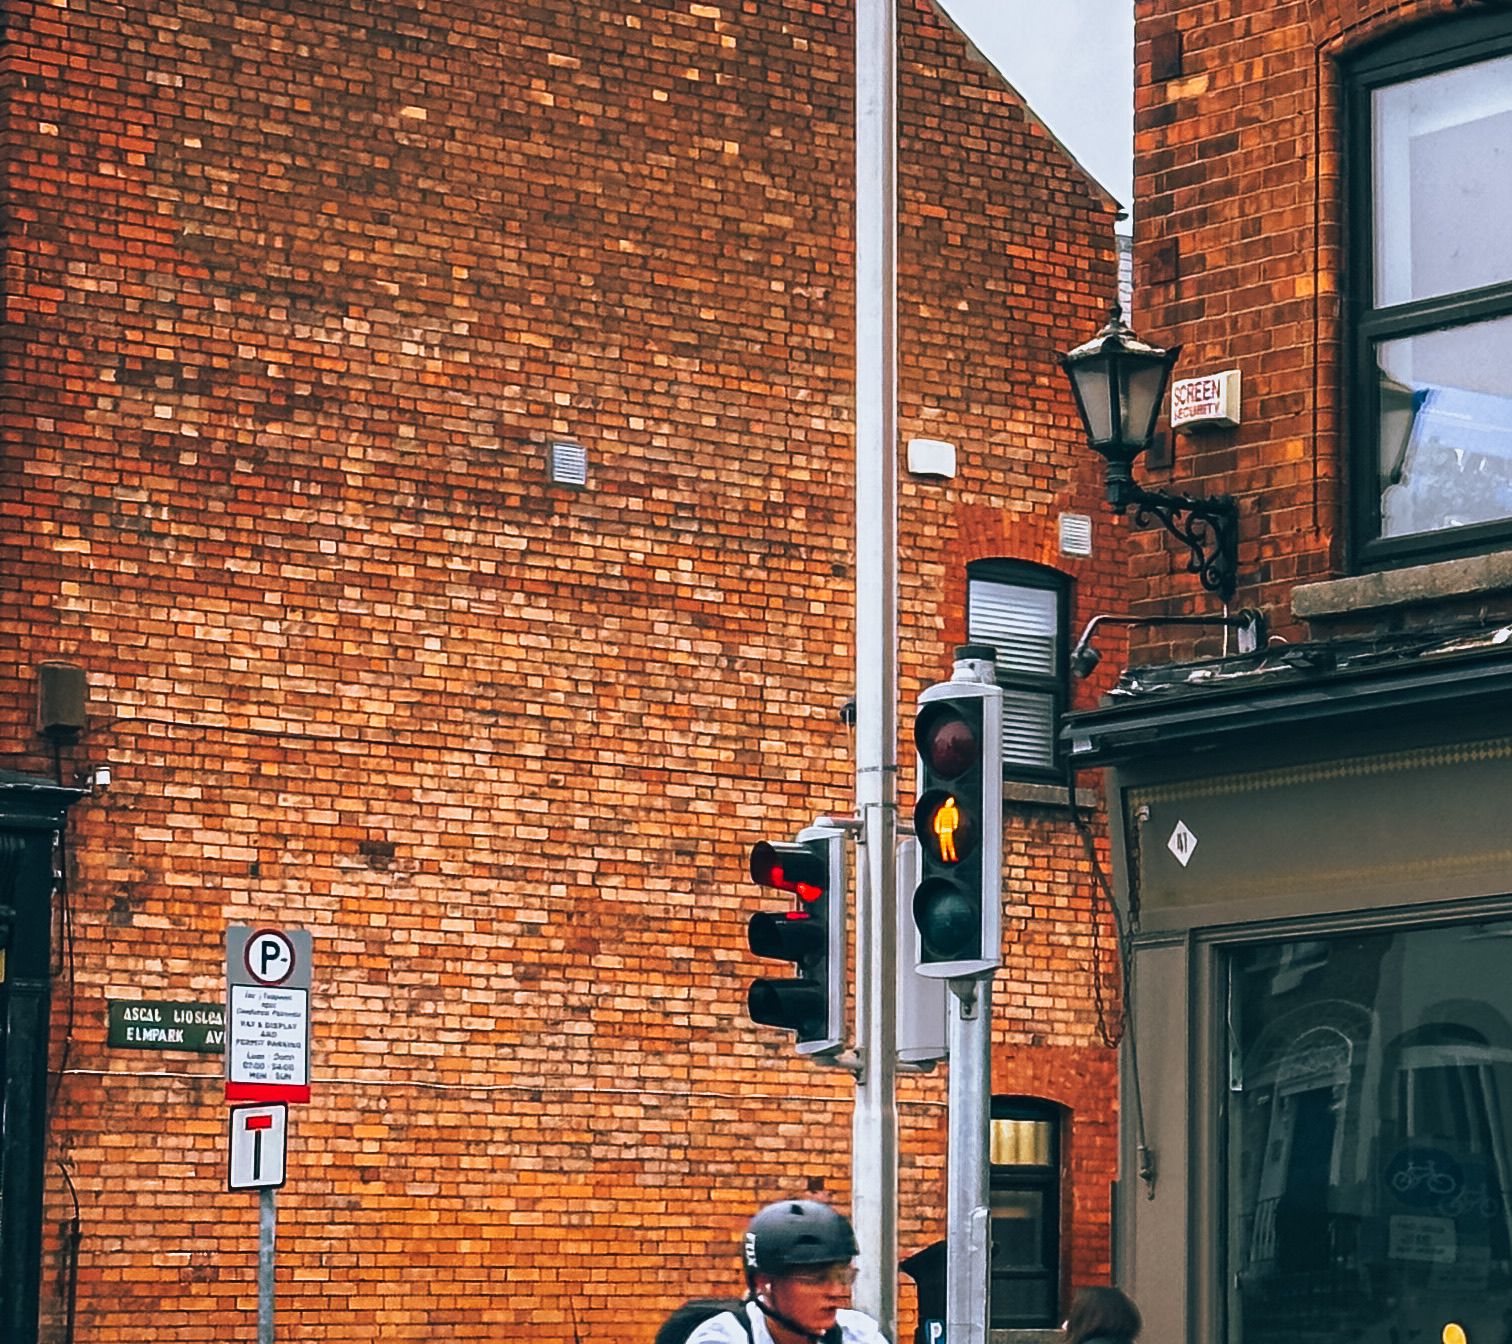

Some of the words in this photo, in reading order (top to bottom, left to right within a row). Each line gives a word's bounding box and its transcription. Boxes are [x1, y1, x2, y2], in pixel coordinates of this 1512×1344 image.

[1174, 379, 1221, 405] SCREEN
[1177, 832, 1187, 853] 41
[261, 940, 281, 975] P
[123, 1007, 162, 1023] ASCAL
[173, 1009, 226, 1026] LIOSLEA
[126, 1027, 184, 1043] ELMPARK
[205, 1030, 226, 1044] AV
